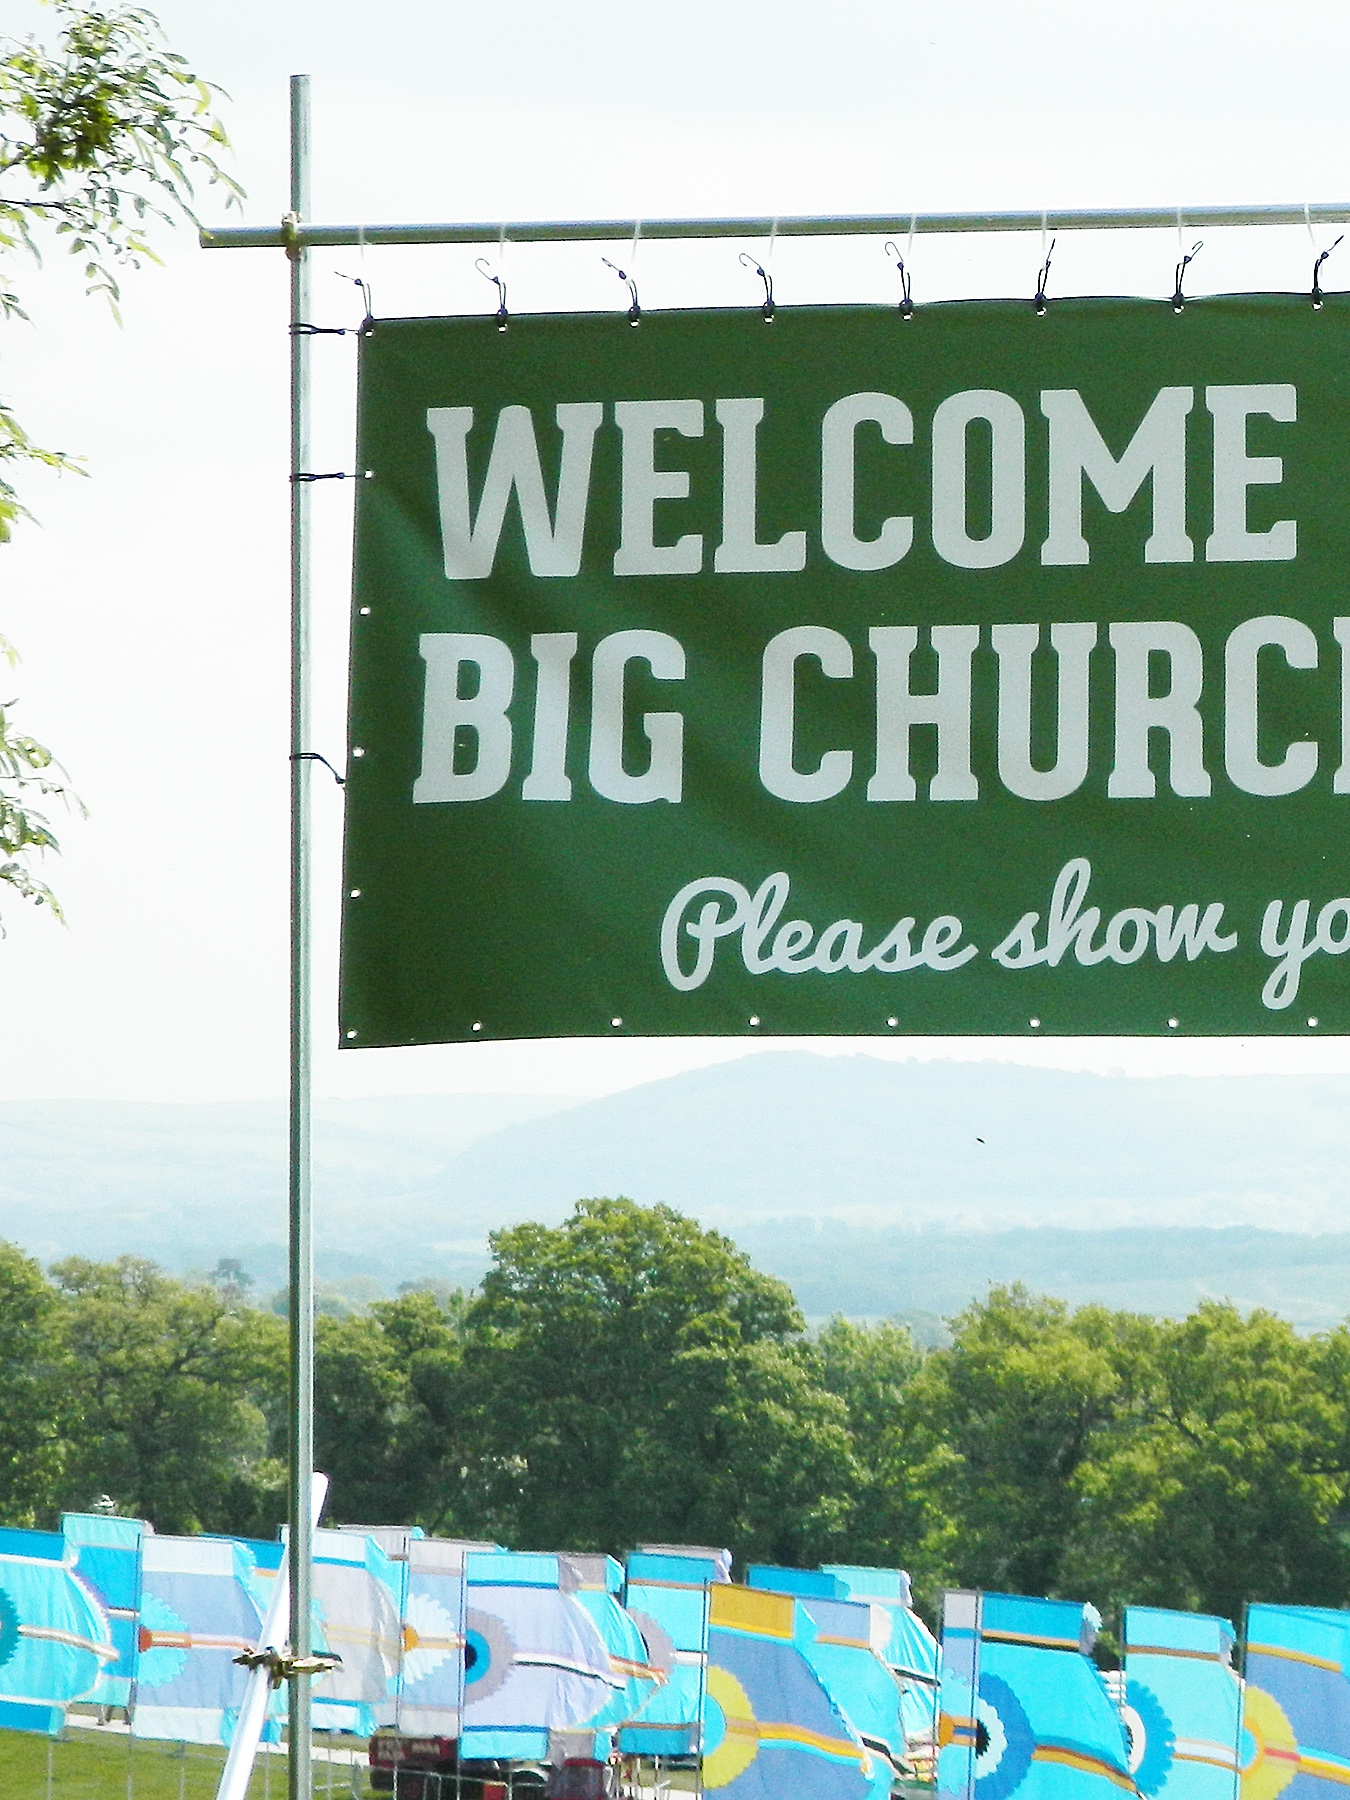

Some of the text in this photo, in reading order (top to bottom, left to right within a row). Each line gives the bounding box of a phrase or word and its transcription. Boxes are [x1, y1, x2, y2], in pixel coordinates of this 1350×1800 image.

[426, 383, 1296, 580] WELCOME
[412, 629, 686, 804] BIG
[660, 871, 978, 991] Please
[990, 857, 1238, 969] show
